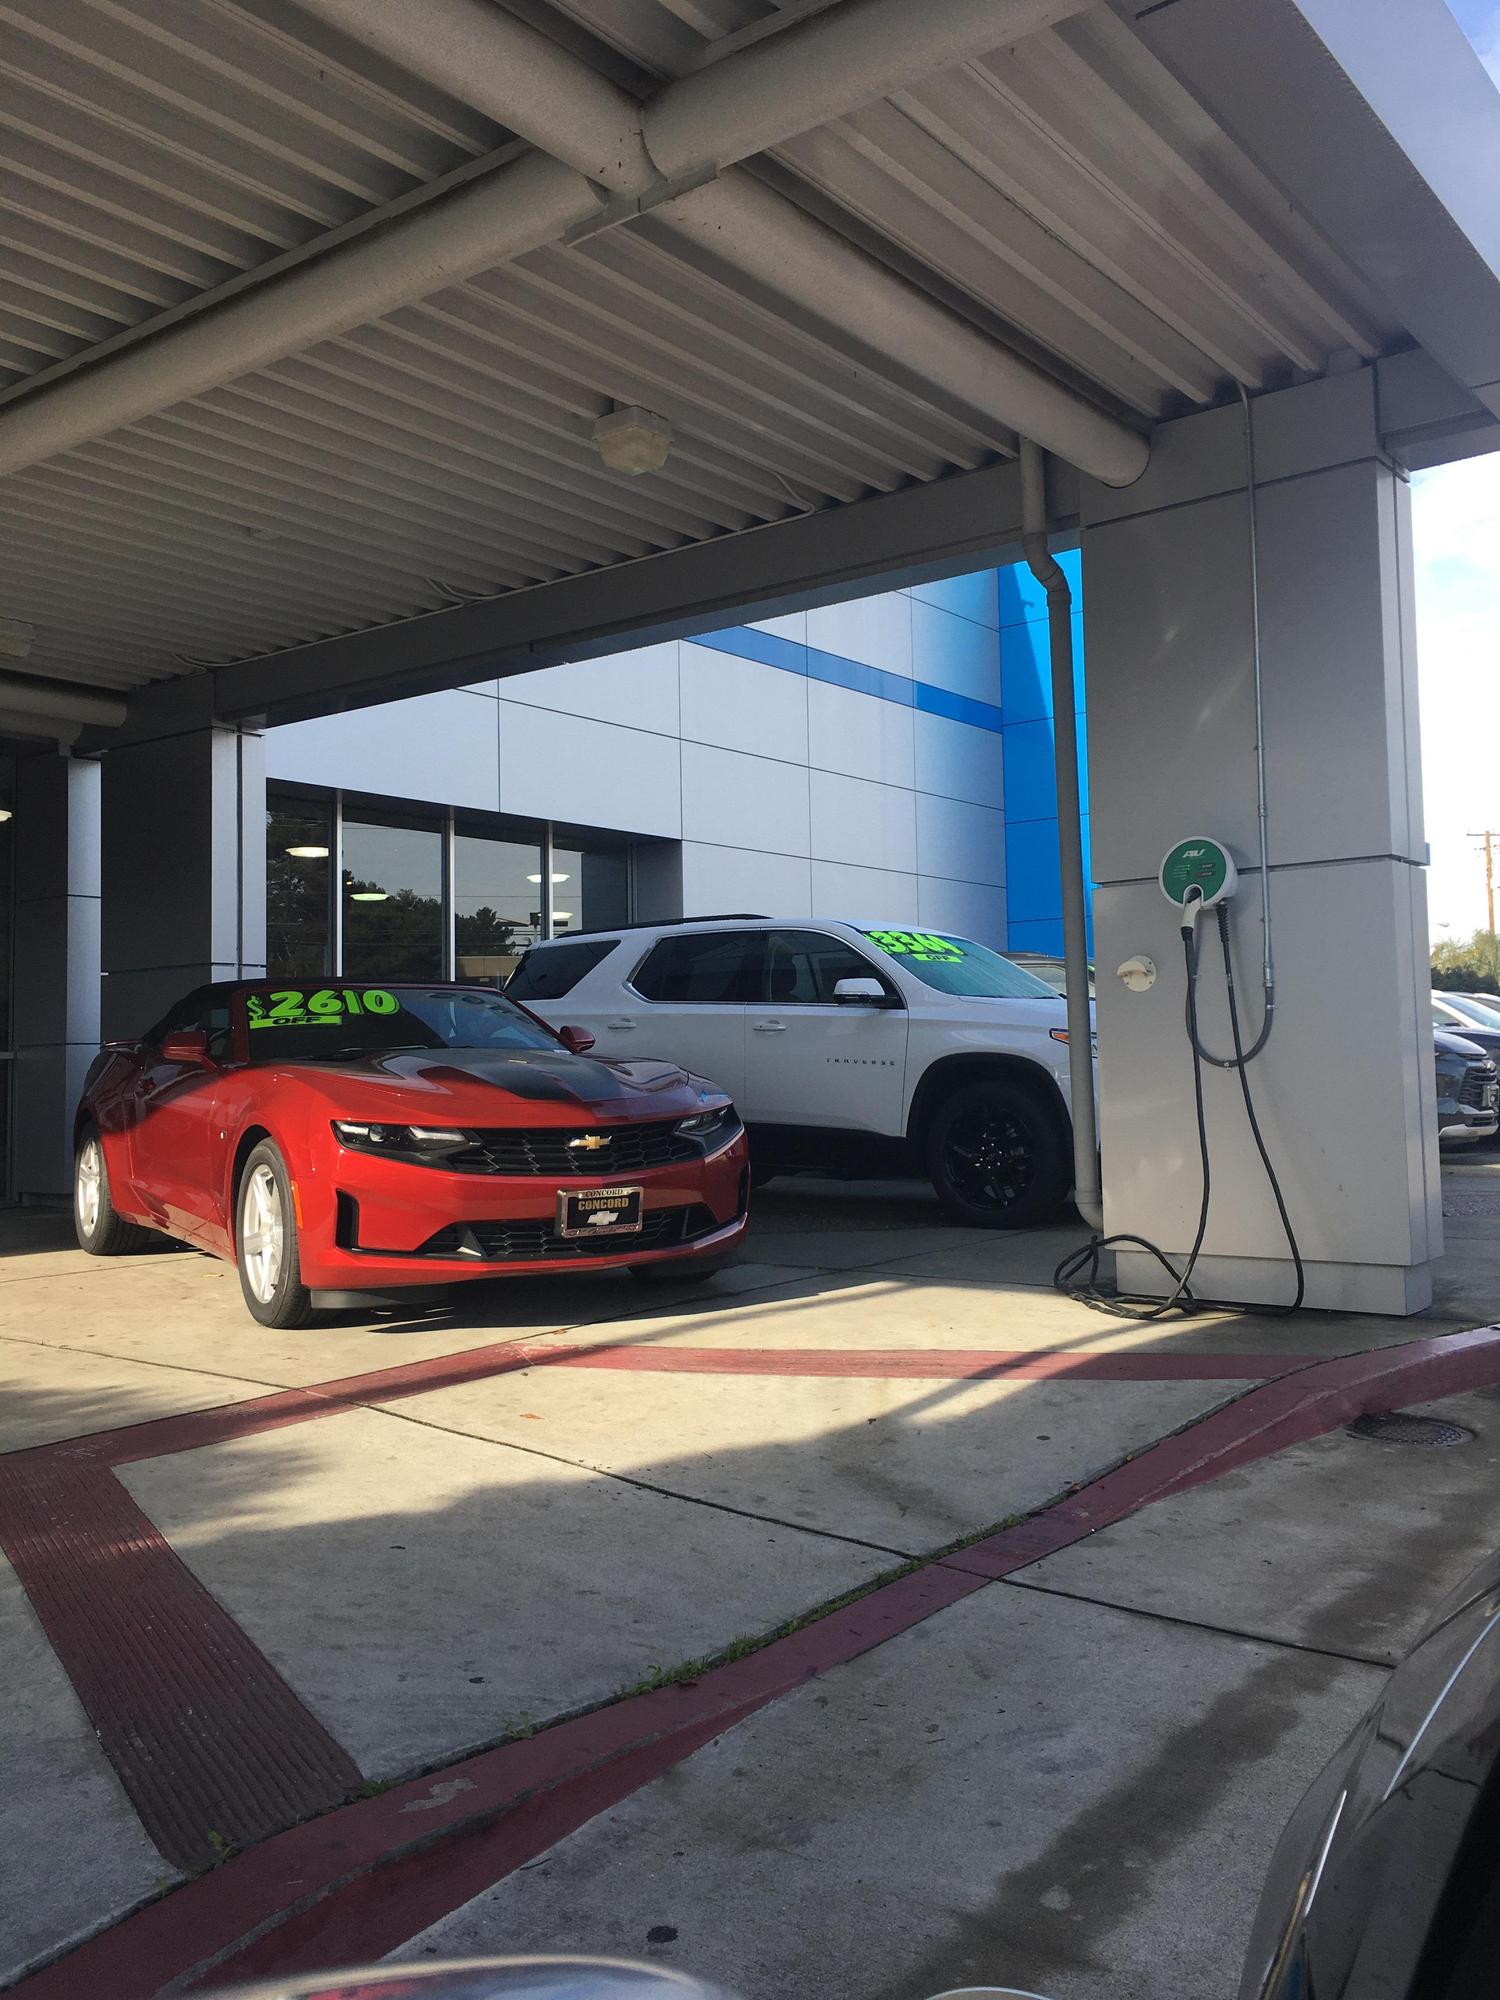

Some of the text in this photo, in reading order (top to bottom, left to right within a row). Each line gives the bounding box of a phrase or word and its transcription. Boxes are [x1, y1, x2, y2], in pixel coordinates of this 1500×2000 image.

[246, 988, 399, 1021] $2610
[271, 1016, 321, 1026] OFF
[826, 1057, 896, 1066] TRAVERSE
[585, 1188, 624, 1198] CONCORD
[578, 1197, 629, 1211] CONCORD
